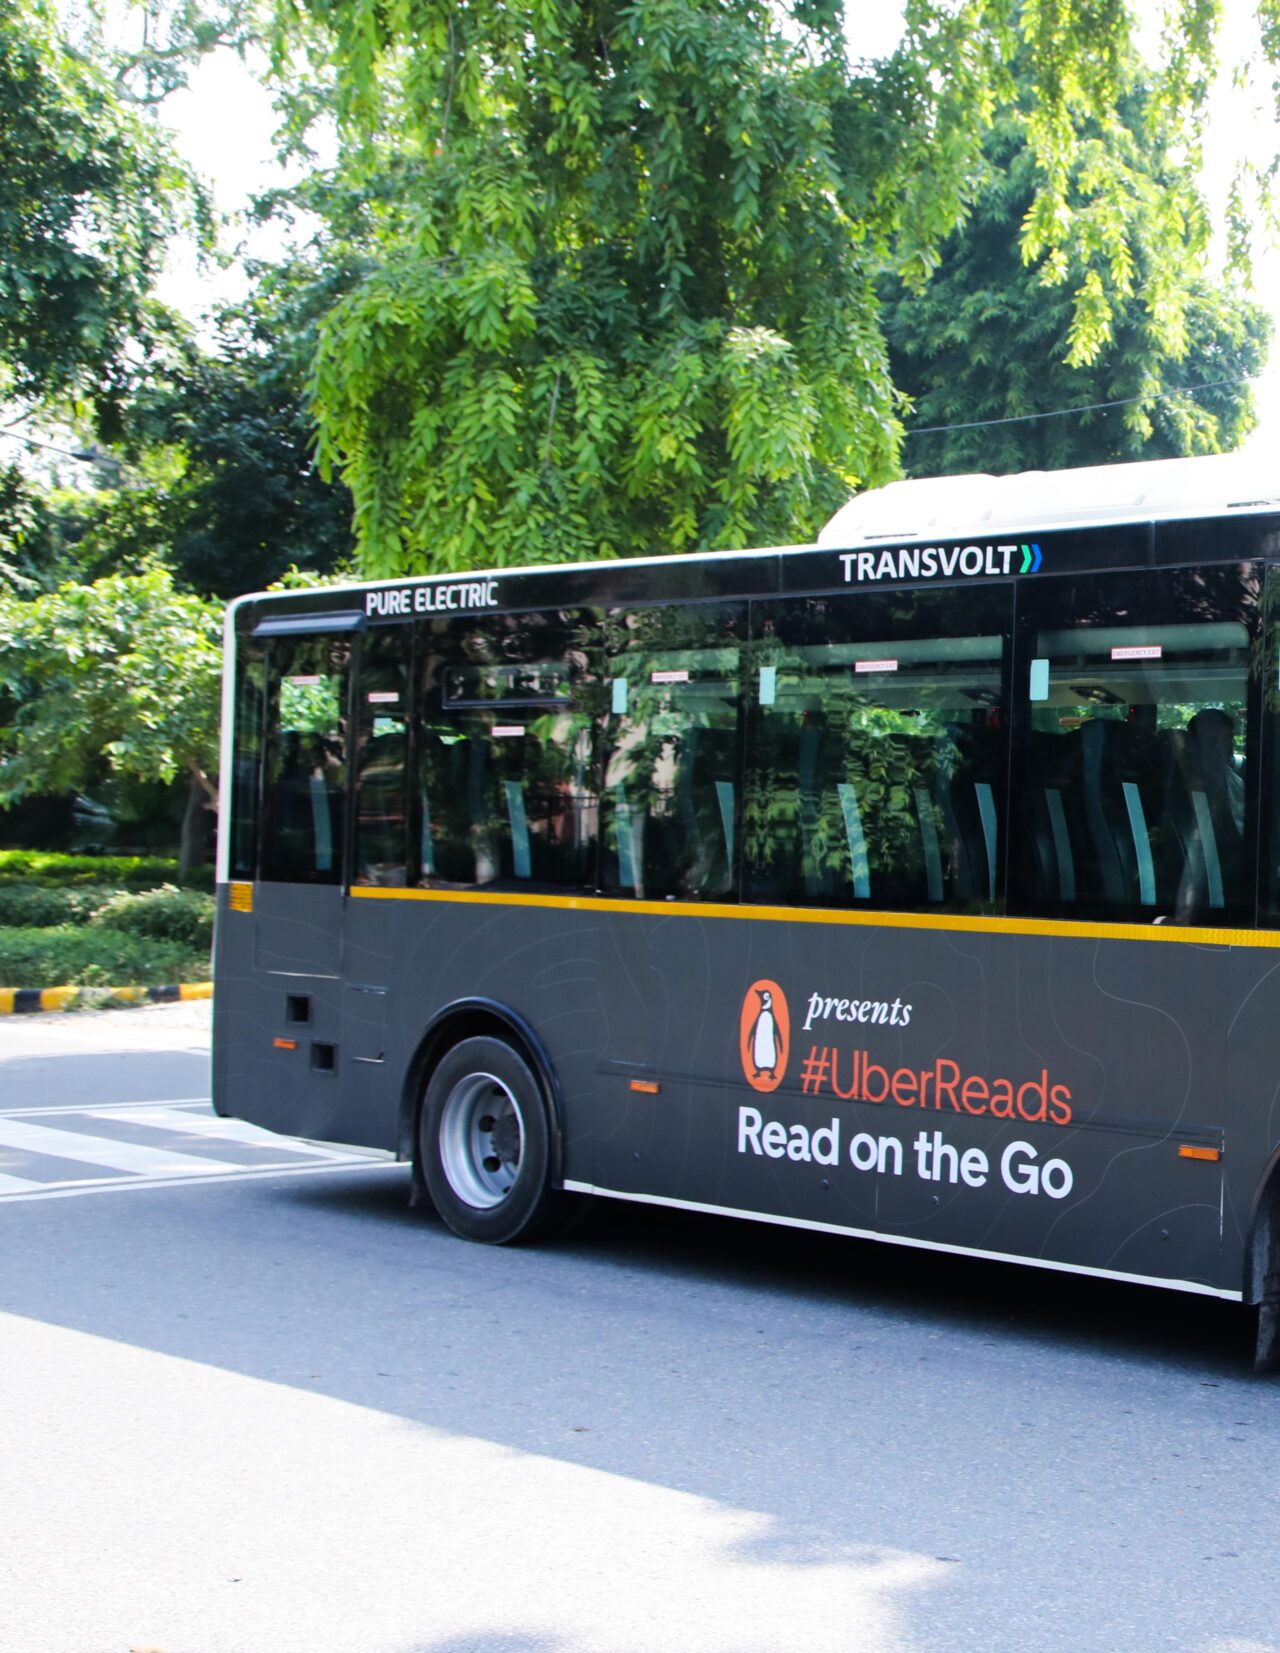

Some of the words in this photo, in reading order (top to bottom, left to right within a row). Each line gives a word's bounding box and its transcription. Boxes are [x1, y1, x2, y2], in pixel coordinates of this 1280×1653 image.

[839, 545, 1018, 582] TRANSVOLT
[366, 589, 412, 617] PURE
[414, 581, 499, 612] ELECTRIC
[802, 992, 912, 1030] presents
[801, 1046, 1072, 1125] #UberReads
[738, 1106, 840, 1166] Read
[850, 1132, 903, 1176] on
[913, 1130, 989, 1187] the
[1001, 1140, 1073, 1199] Go
